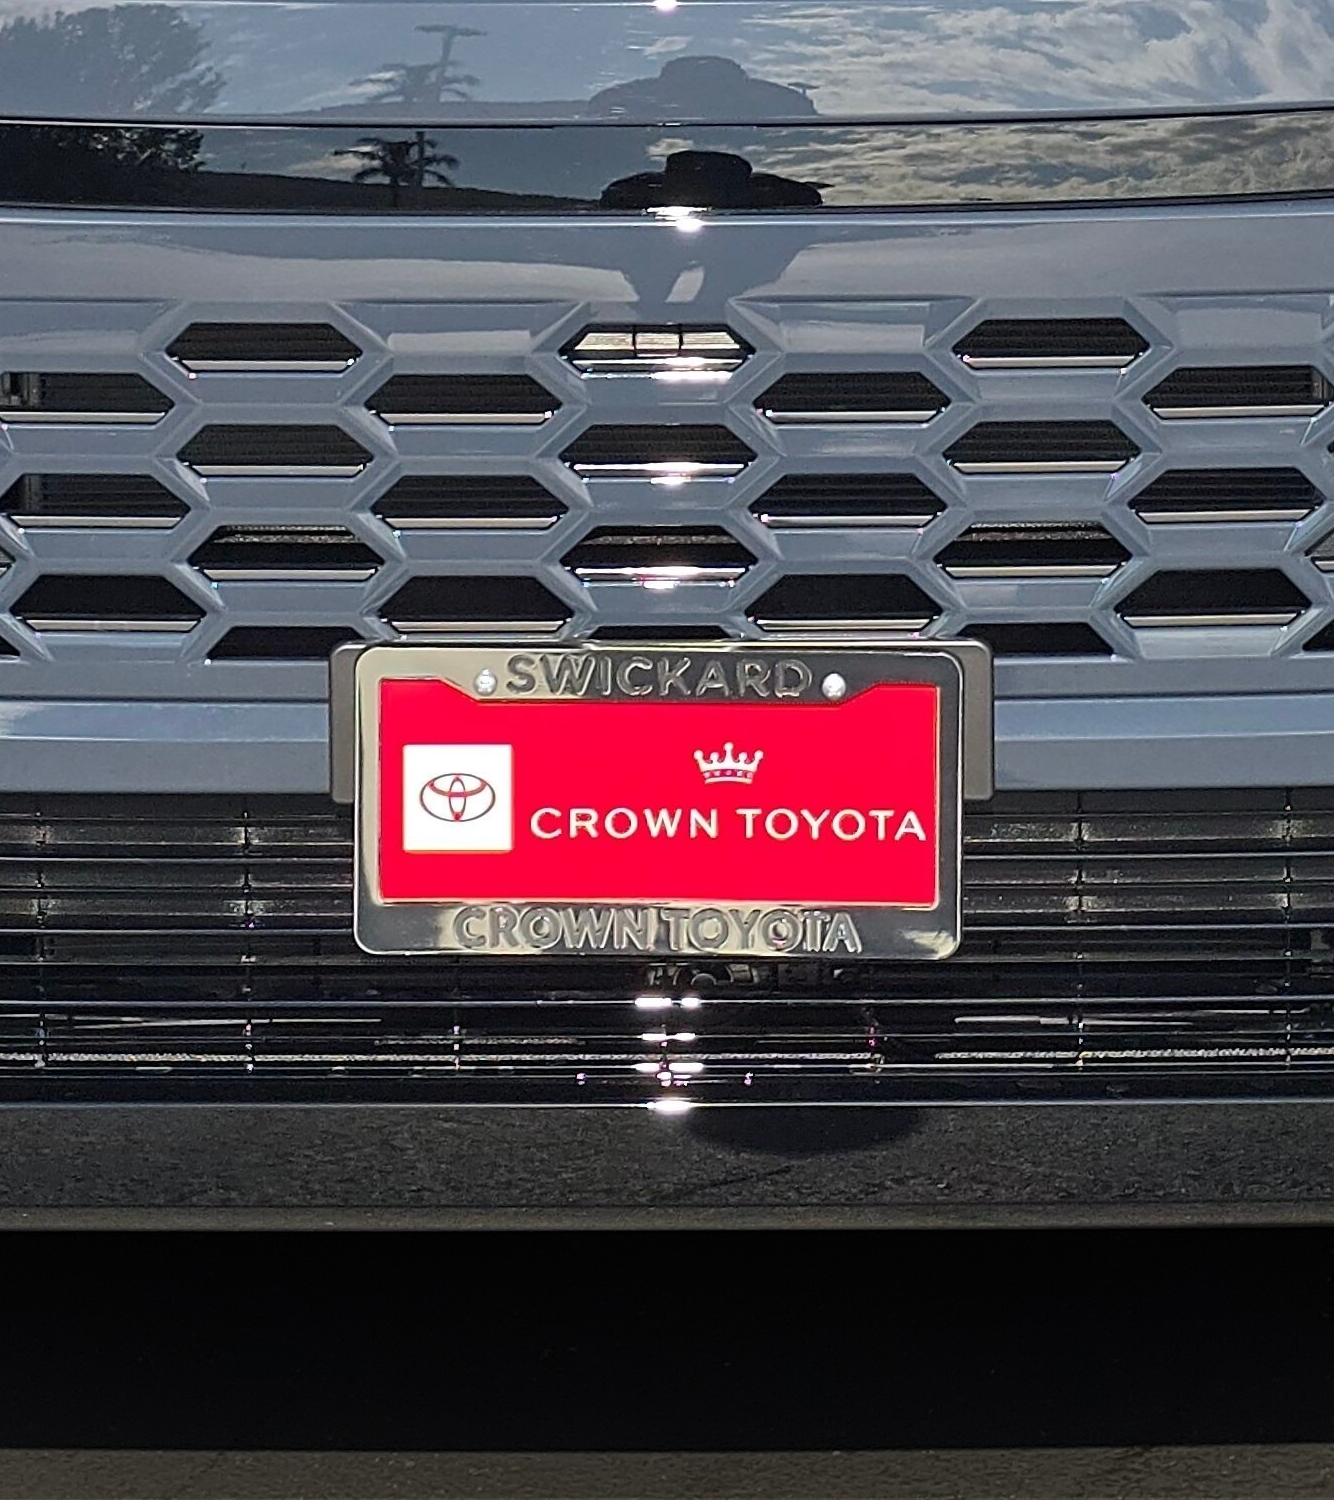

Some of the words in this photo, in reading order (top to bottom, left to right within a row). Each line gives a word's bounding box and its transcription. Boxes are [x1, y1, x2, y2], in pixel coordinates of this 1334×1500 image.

[504, 653, 812, 699] SWICKARD
[530, 806, 719, 841] CROWN
[735, 807, 928, 841] TOYOTA
[453, 905, 655, 952] CROWN
[662, 906, 863, 954] TOYOTA
